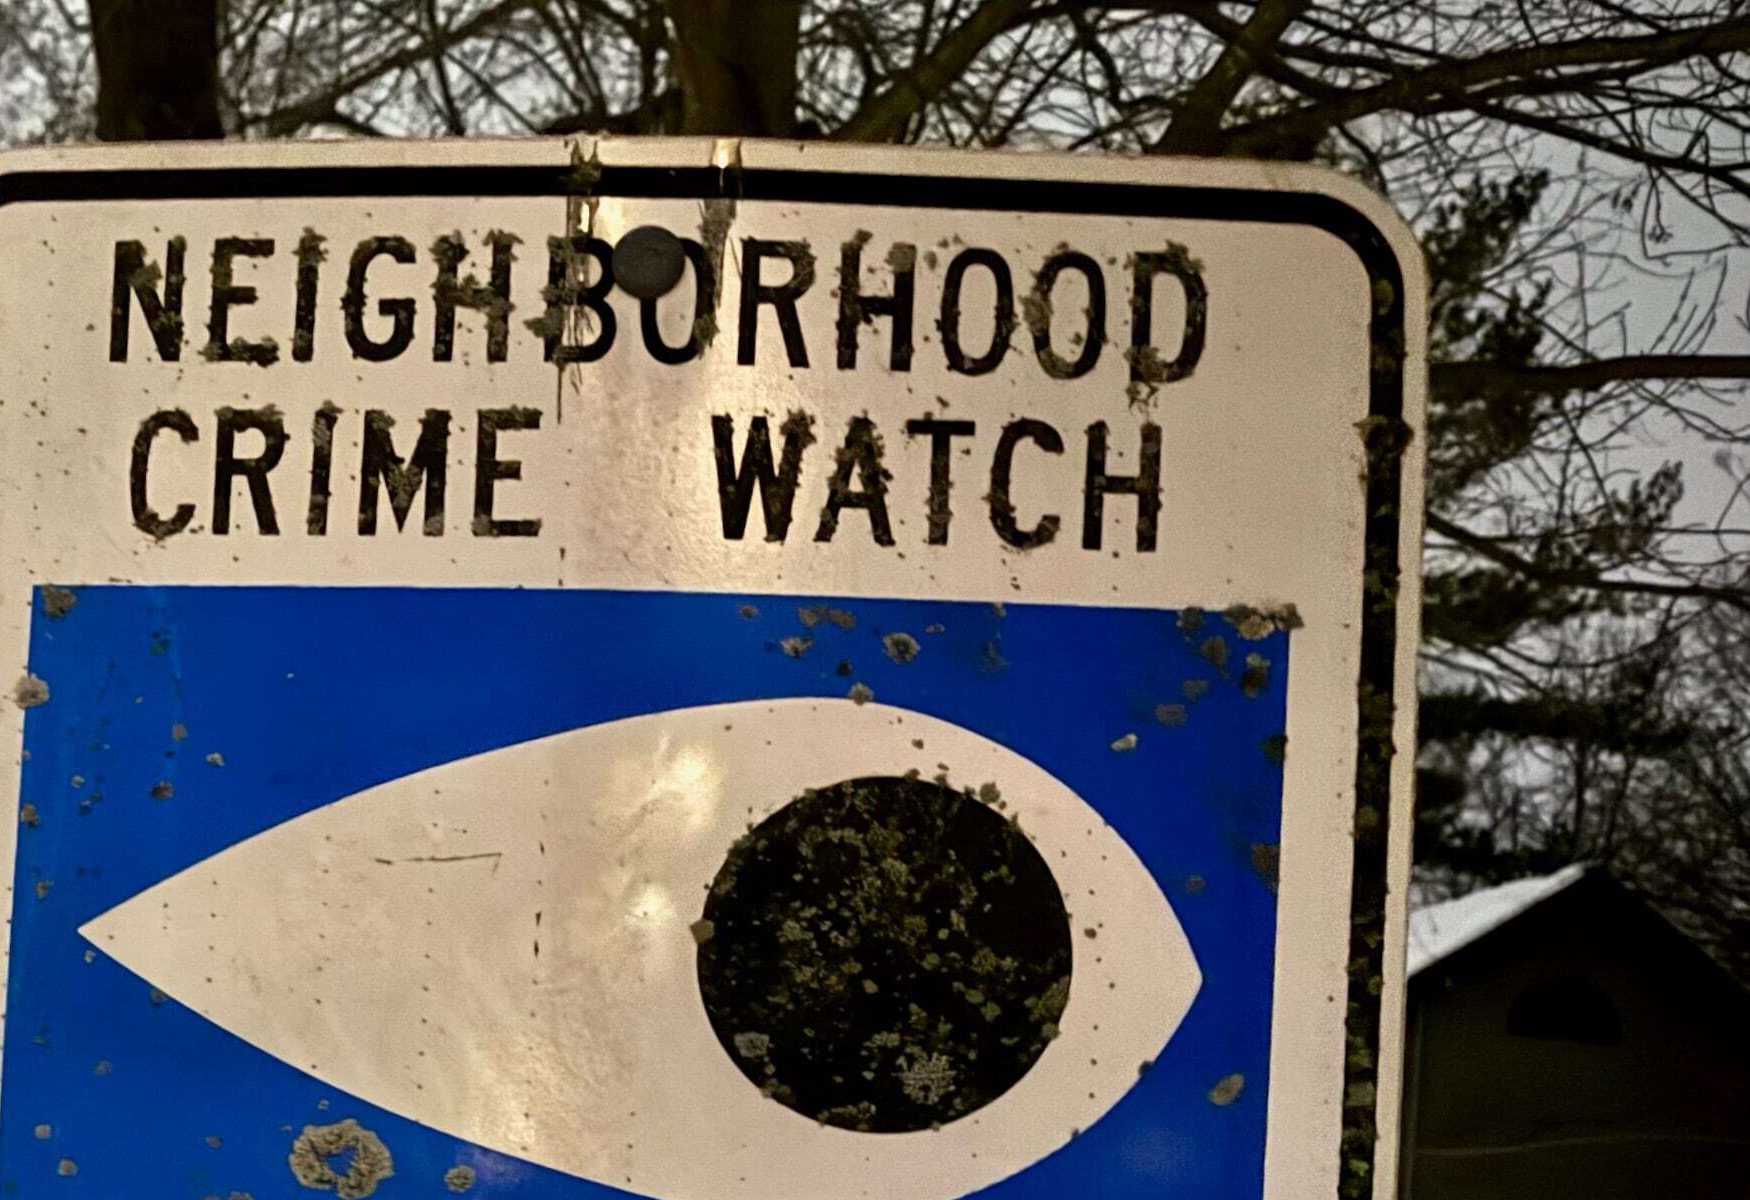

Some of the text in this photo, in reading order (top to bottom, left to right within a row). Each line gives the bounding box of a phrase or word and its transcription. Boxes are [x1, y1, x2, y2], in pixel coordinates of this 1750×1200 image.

[109, 235, 1209, 384] NEIGHBORHOOD
[129, 408, 1164, 553] CRIME WATCH
